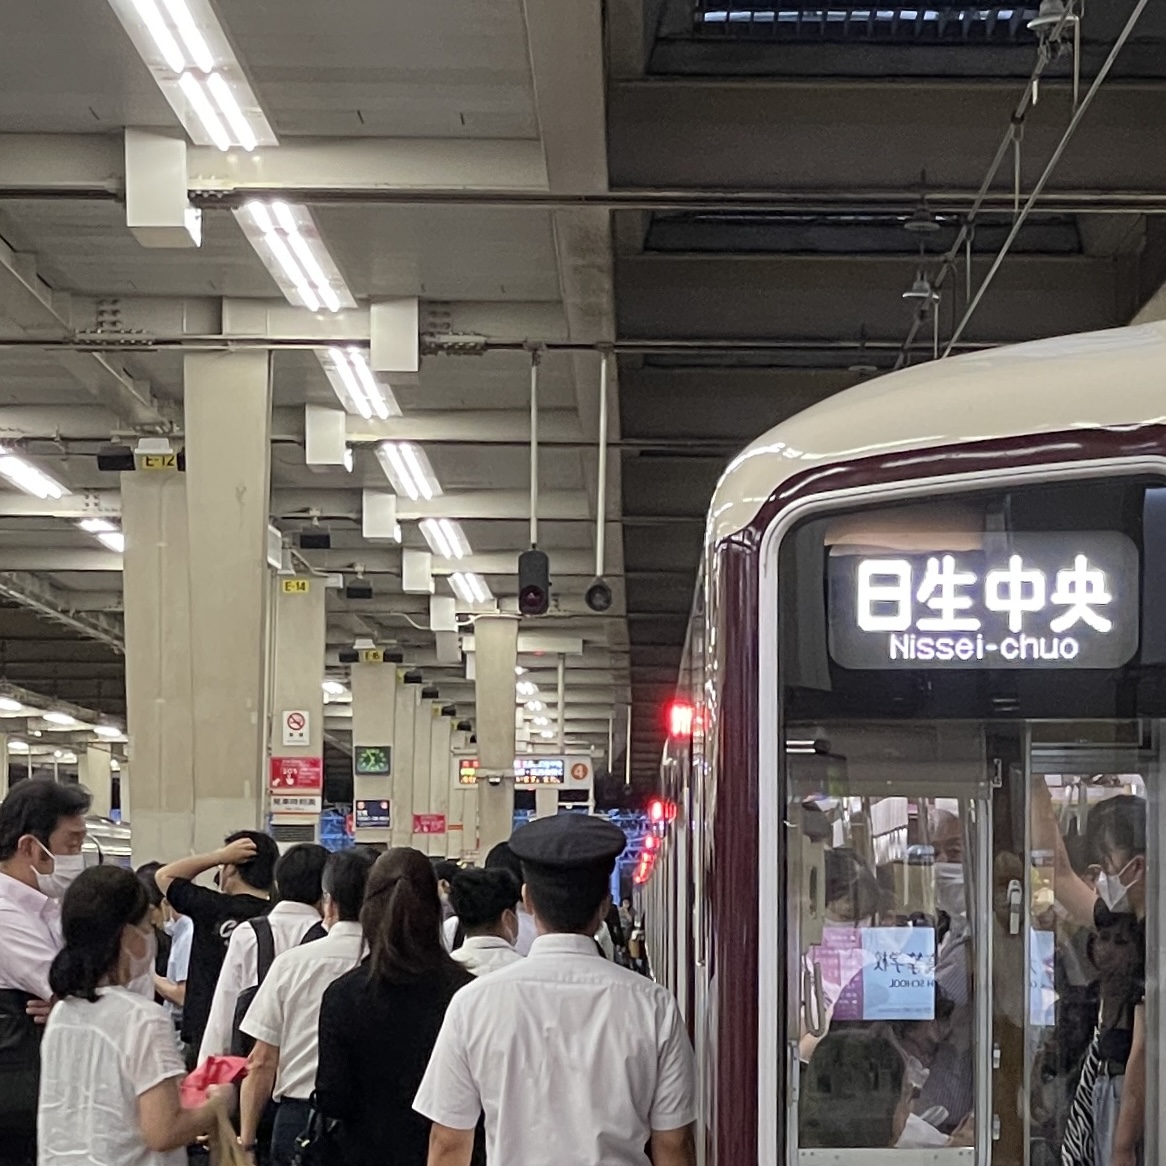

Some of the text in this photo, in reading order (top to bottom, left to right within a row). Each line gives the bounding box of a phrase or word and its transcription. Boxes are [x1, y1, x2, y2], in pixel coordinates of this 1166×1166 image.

[145, 455, 175, 467] E-12
[284, 581, 306, 592] E-14
[856, 554, 1113, 633] 日生中央
[889, 633, 1079, 661] Nissei-chuo
